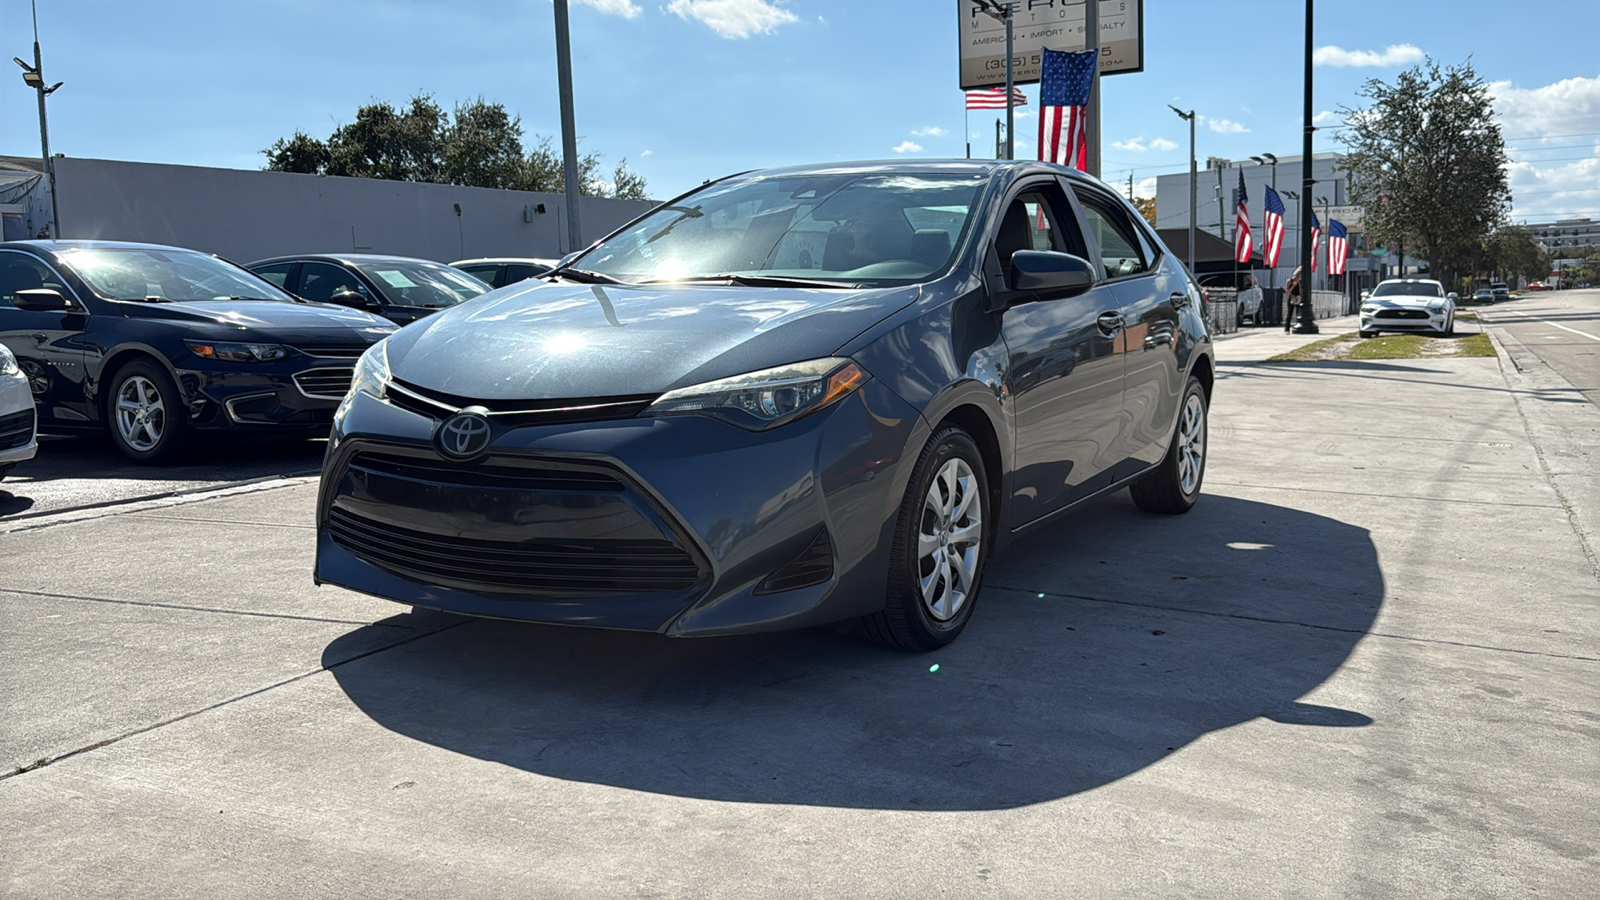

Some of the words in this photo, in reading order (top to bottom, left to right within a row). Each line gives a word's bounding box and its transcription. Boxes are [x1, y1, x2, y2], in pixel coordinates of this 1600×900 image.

[972, 35, 1017, 46] AMERICN
[1030, 29, 1064, 39] IMPORT
[1077, 22, 1126, 34] SIALTY
